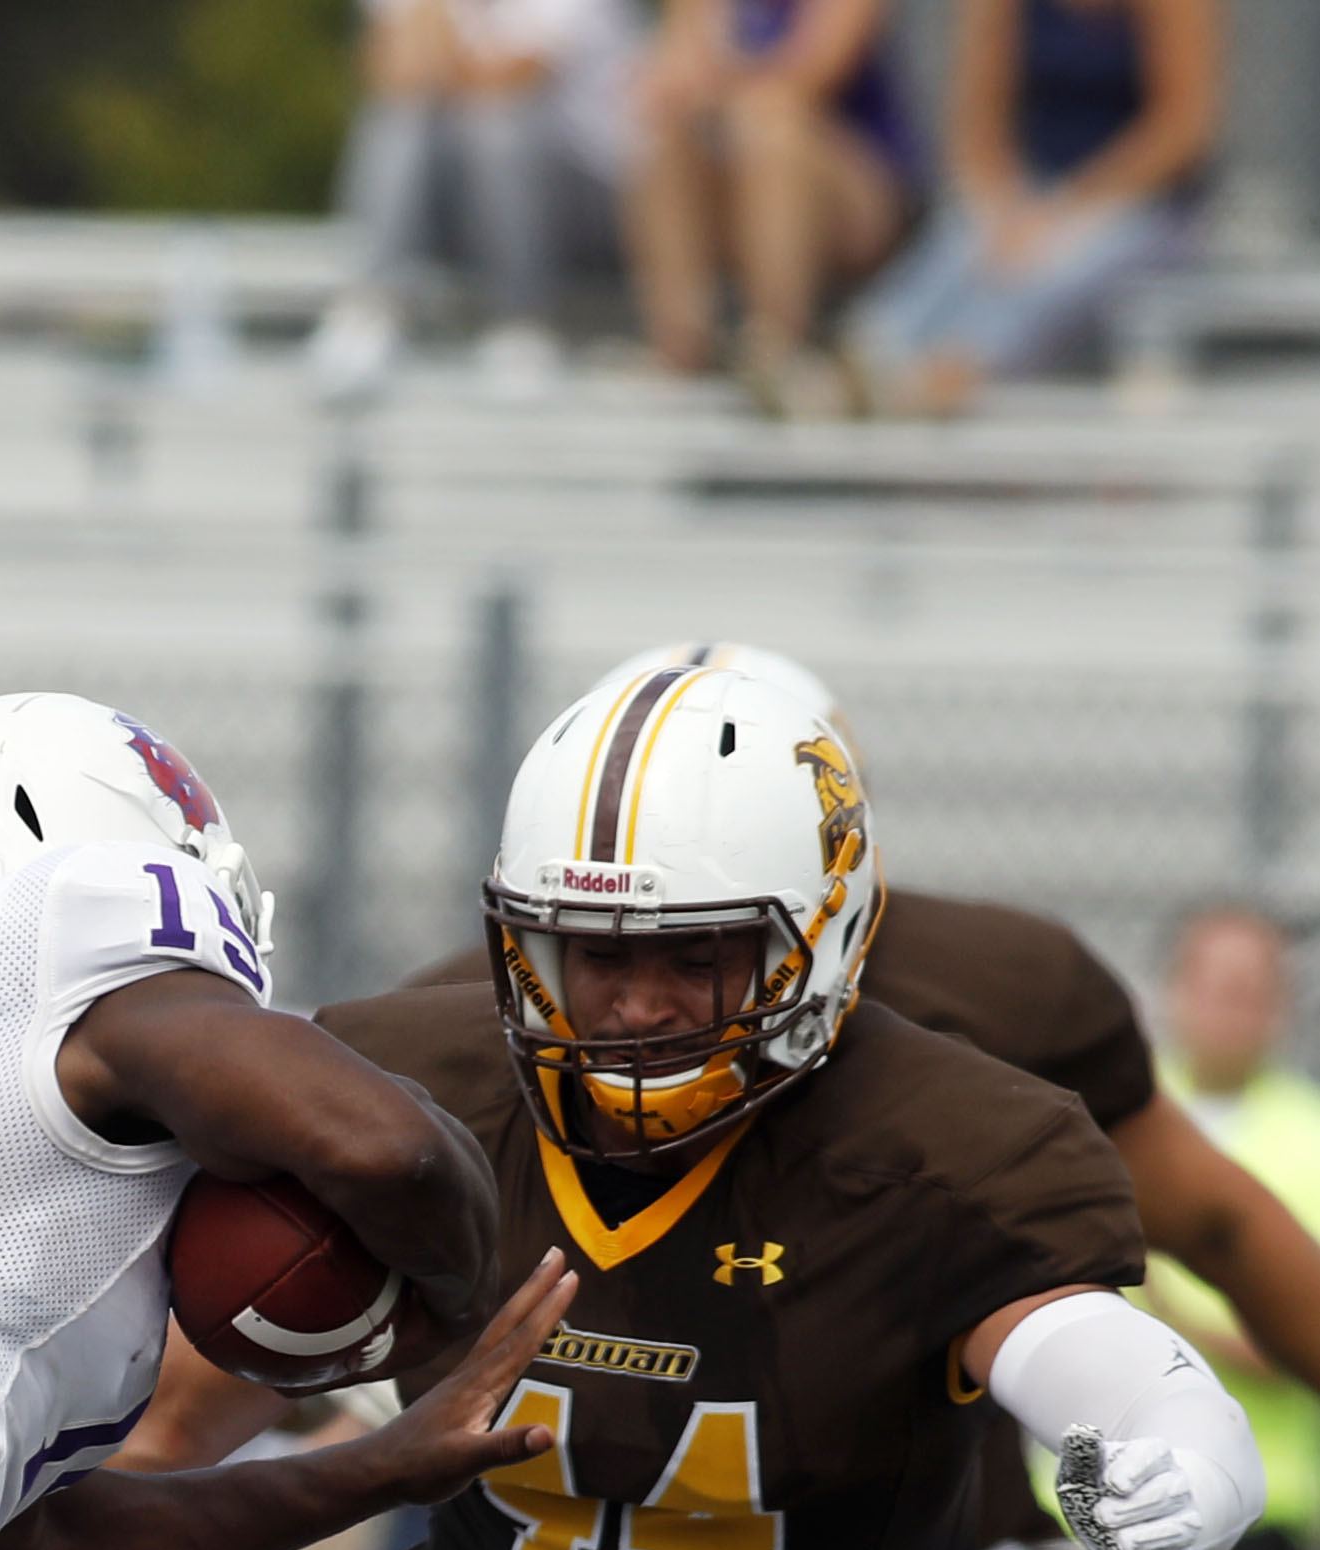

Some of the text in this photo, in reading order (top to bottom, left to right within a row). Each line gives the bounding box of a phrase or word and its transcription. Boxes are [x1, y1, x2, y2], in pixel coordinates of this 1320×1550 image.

[563, 868, 631, 893] Riddell
[143, 862, 265, 993] 15
[503, 946, 557, 1024] Riddell
